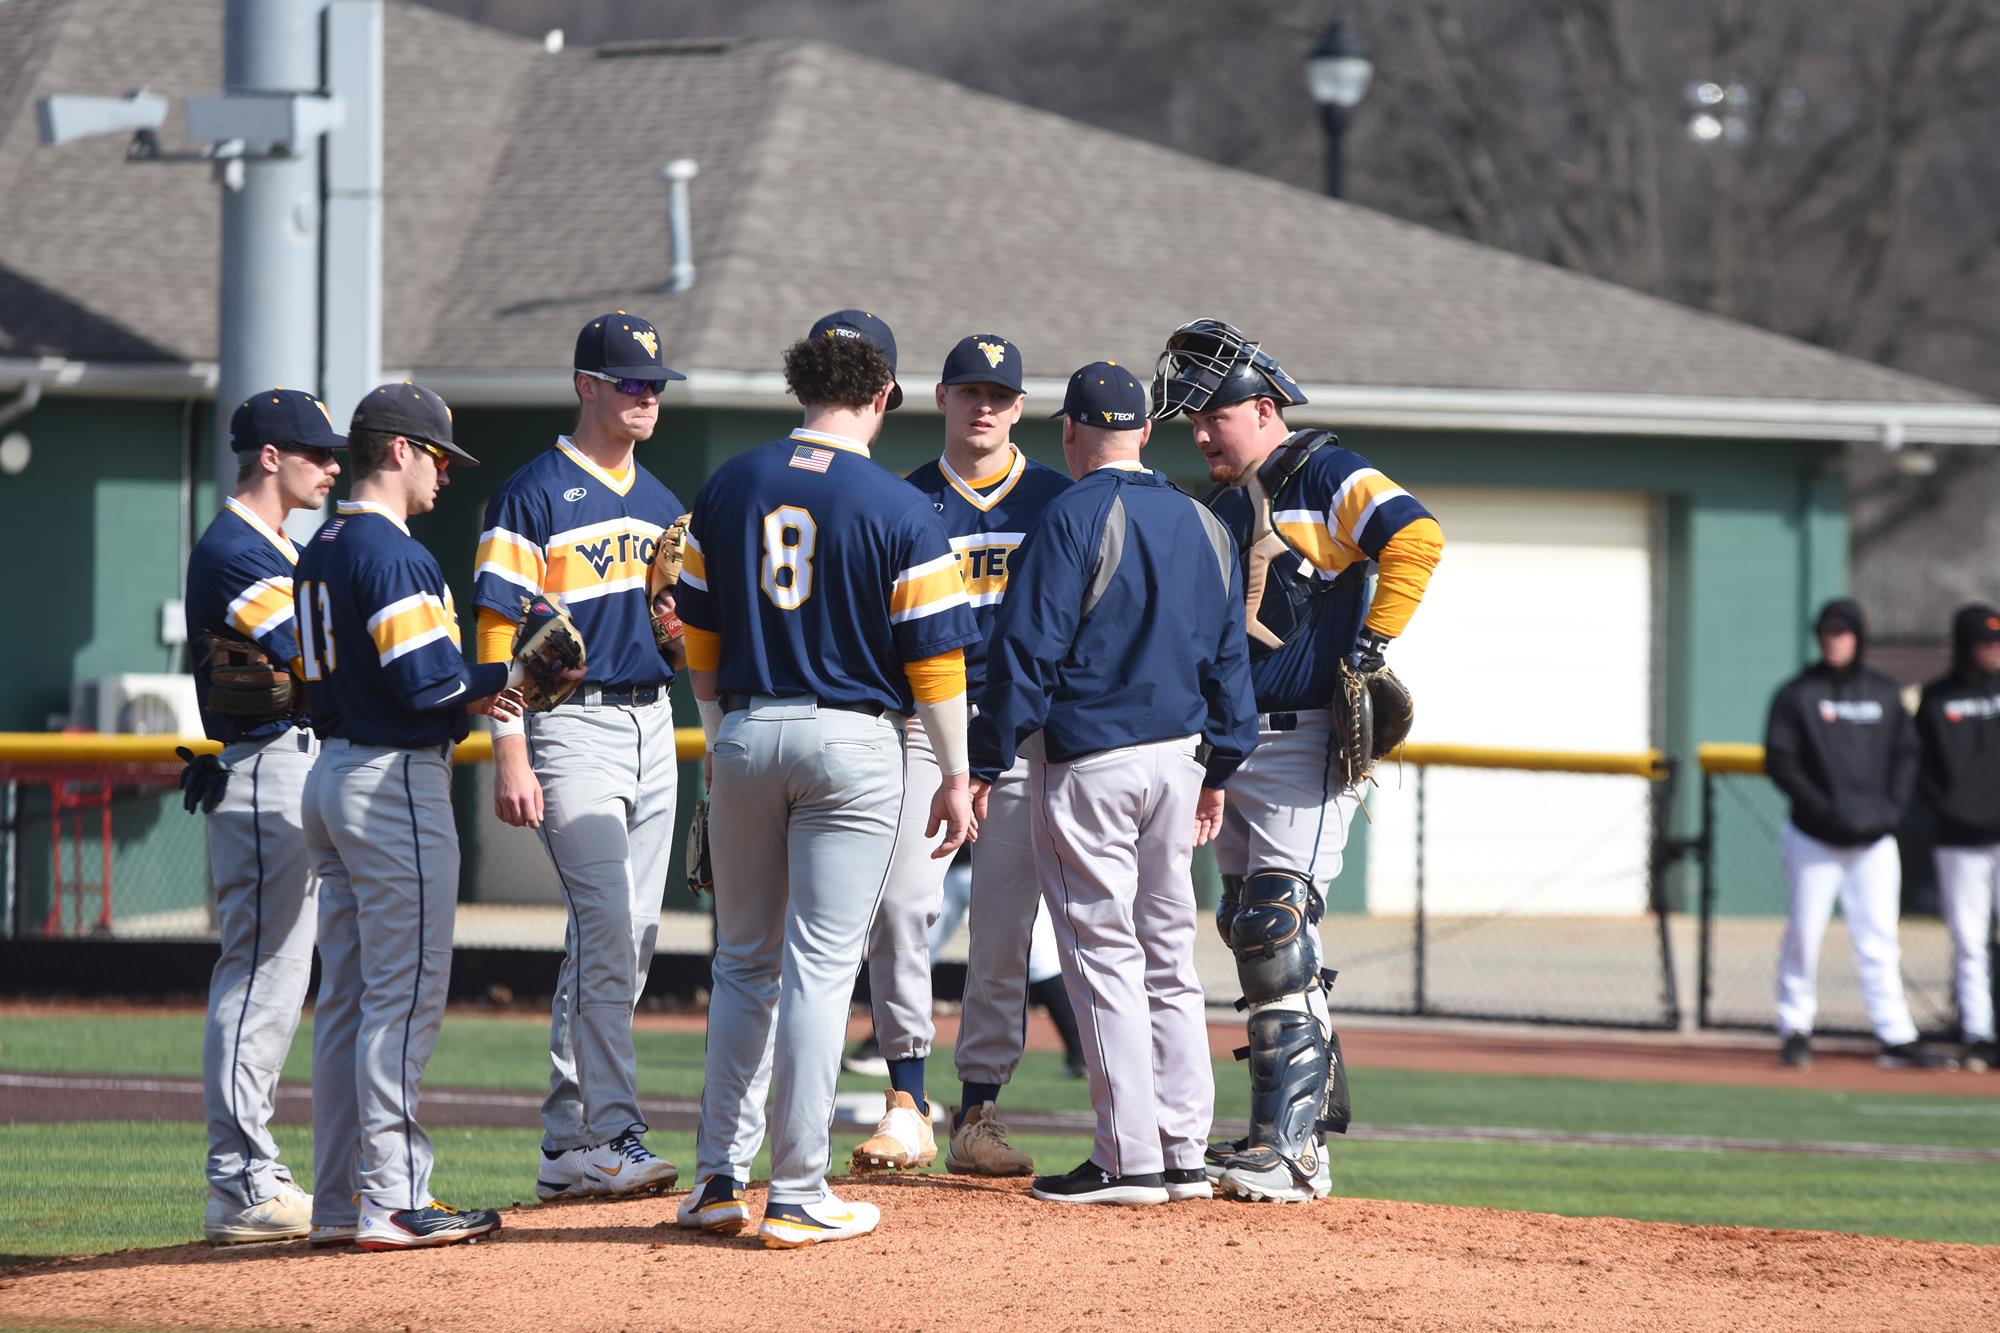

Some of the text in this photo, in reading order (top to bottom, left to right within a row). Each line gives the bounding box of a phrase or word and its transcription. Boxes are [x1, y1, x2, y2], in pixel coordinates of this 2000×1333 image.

[836, 328, 861, 339] TECH
[1113, 412, 1135, 421] TECH
[617, 533, 656, 566] TEC
[761, 504, 817, 611] 8
[299, 580, 337, 681] 13
